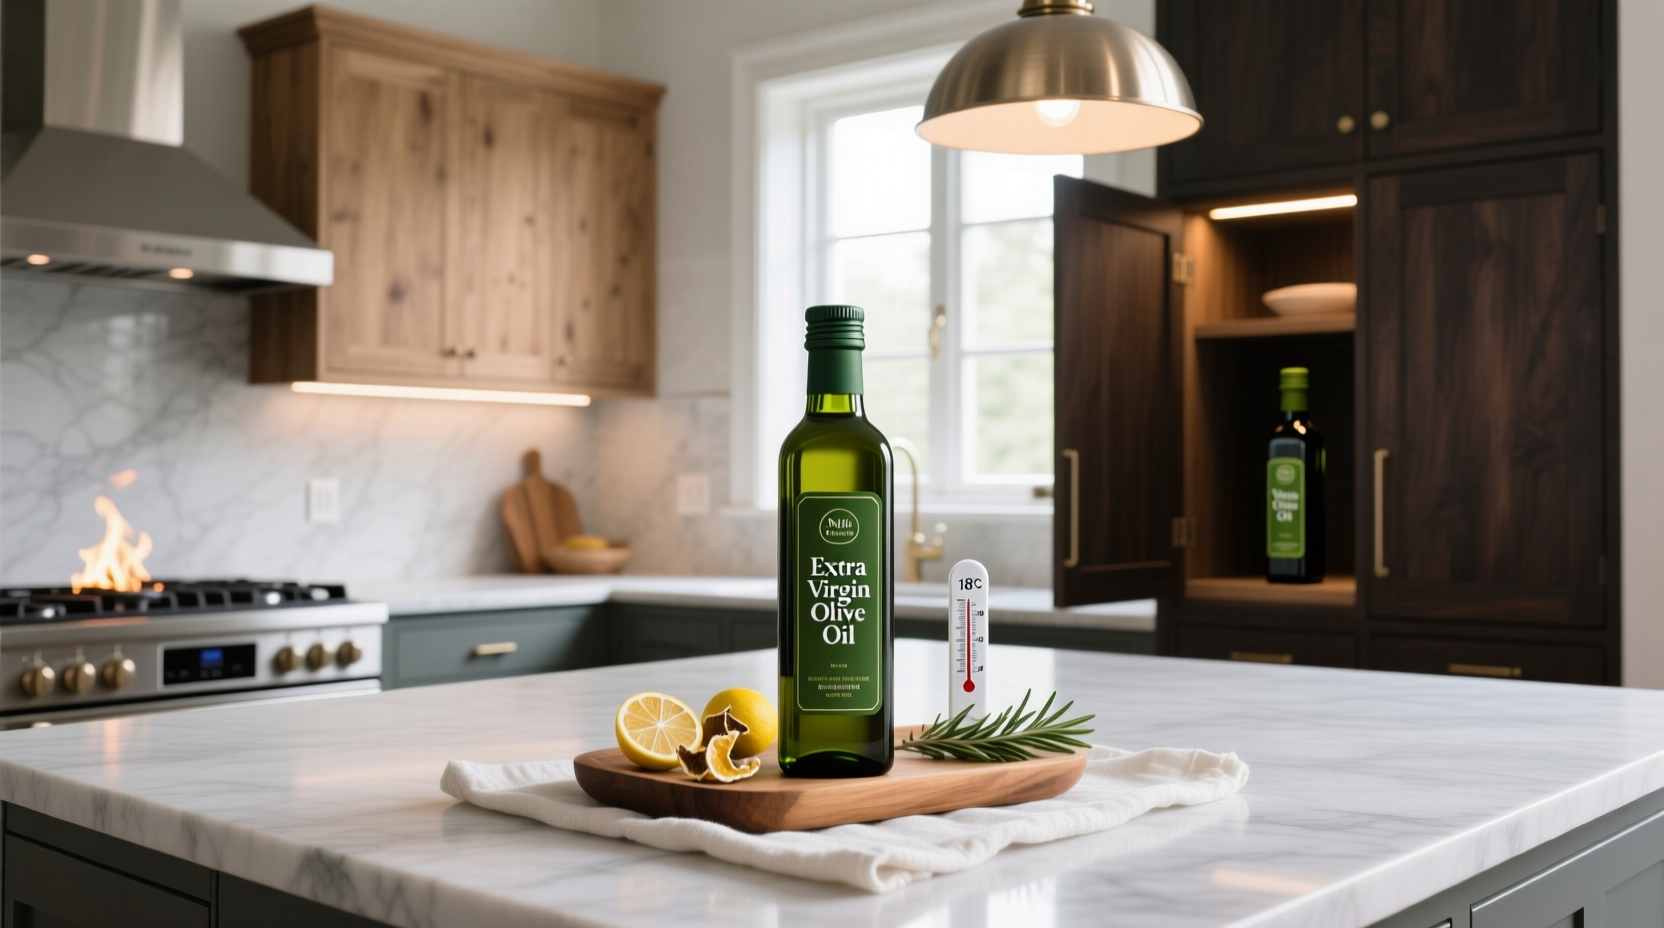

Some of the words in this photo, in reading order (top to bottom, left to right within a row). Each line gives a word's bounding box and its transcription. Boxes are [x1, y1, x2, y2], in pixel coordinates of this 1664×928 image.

[810, 556, 867, 577] Extra
[806, 579, 871, 607] Virgin
[810, 601, 866, 622] Olive
[822, 624, 855, 645] Oil
